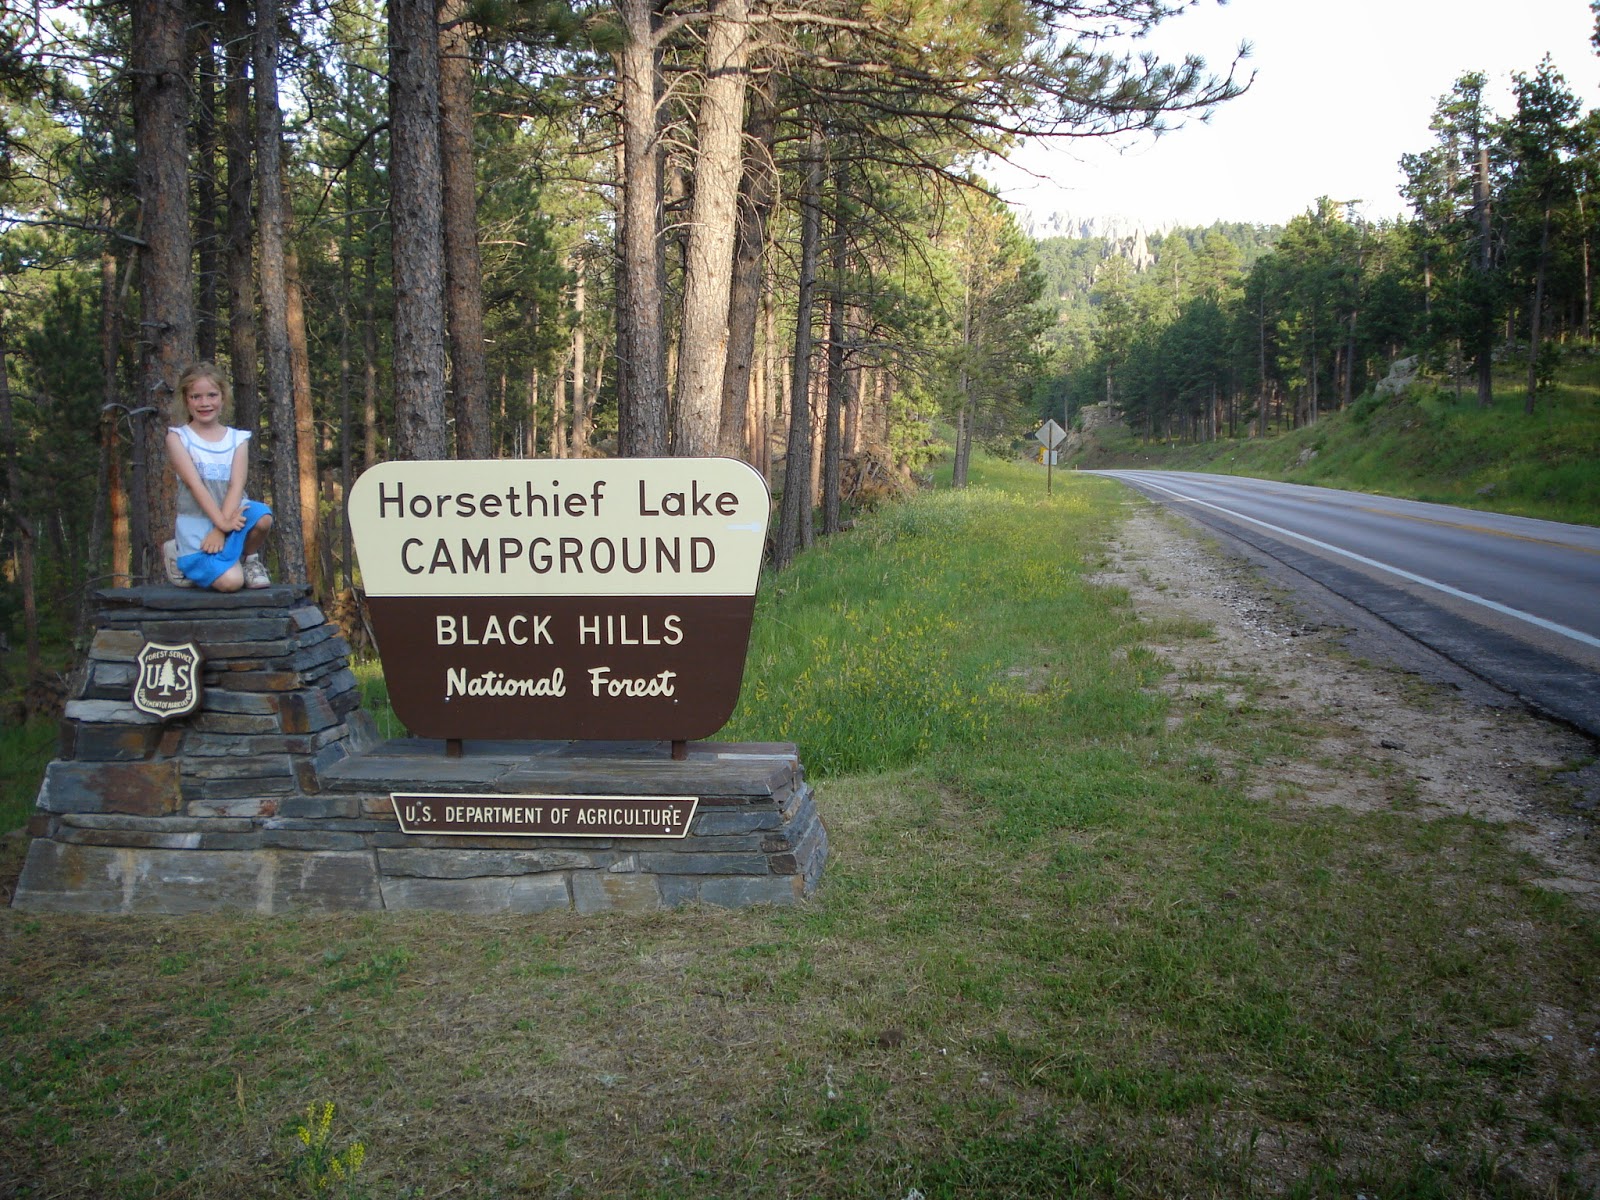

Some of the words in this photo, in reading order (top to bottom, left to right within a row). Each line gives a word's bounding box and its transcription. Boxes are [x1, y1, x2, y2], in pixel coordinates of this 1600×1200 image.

[379, 480, 606, 518] Horsethief
[639, 479, 739, 517] Lake
[401, 536, 716, 575] CAMPGROUND
[436, 615, 554, 646] BLACK
[579, 615, 684, 646] HILLS
[145, 651, 168, 663] FOREST
[168, 651, 192, 664] SERVICE
[446, 667, 566, 698] National
[588, 666, 676, 698] Forest
[405, 806, 437, 823] U.S.
[445, 806, 543, 824] DEPARTMENT
[551, 808, 571, 825] OF
[577, 808, 682, 826] AGRICULTURE
